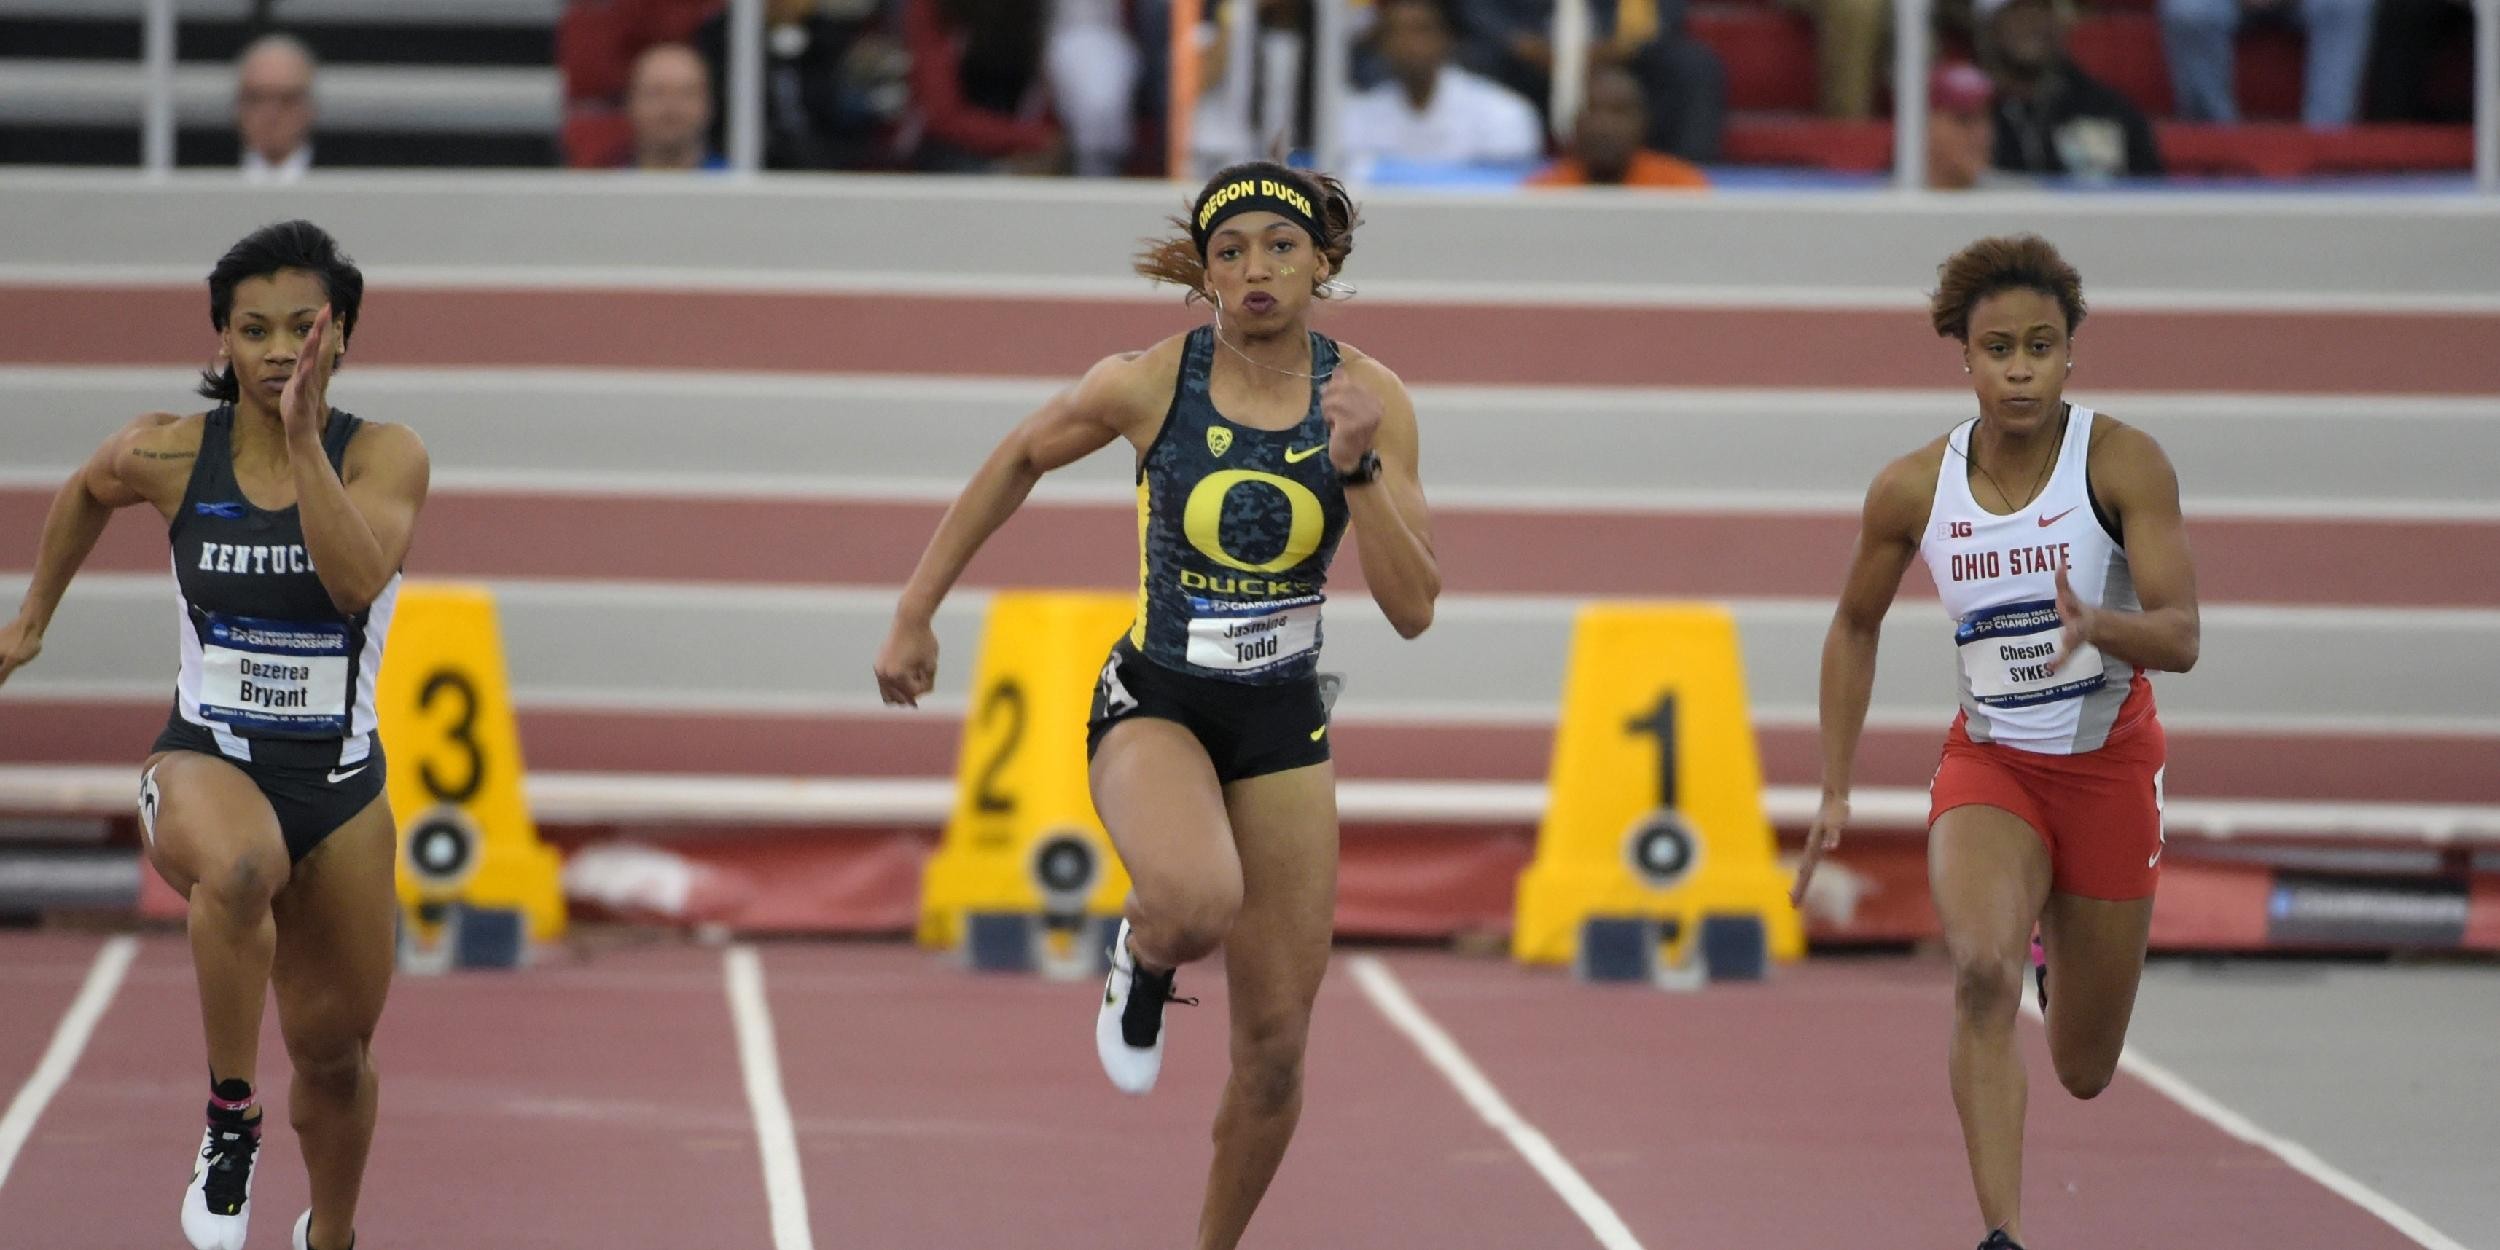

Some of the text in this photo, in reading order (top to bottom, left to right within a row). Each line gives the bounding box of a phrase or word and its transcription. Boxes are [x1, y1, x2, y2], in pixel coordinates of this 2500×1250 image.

[1199, 180, 1313, 231] OREGON DUCKS
[1184, 469, 1325, 573] O
[1951, 543, 2072, 581] OHIO STATE
[1180, 569, 1312, 595] DUCKS
[1223, 616, 1288, 638] Jasmine
[1235, 635, 1278, 663] Todd
[2000, 642, 2056, 661] Chesna
[241, 659, 309, 680] Dezerea
[2010, 663, 2055, 682] SYKES
[241, 680, 308, 707] Bryant
[418, 667, 486, 803] 3
[975, 675, 1027, 814] 2
[1623, 685, 1680, 811] 1
